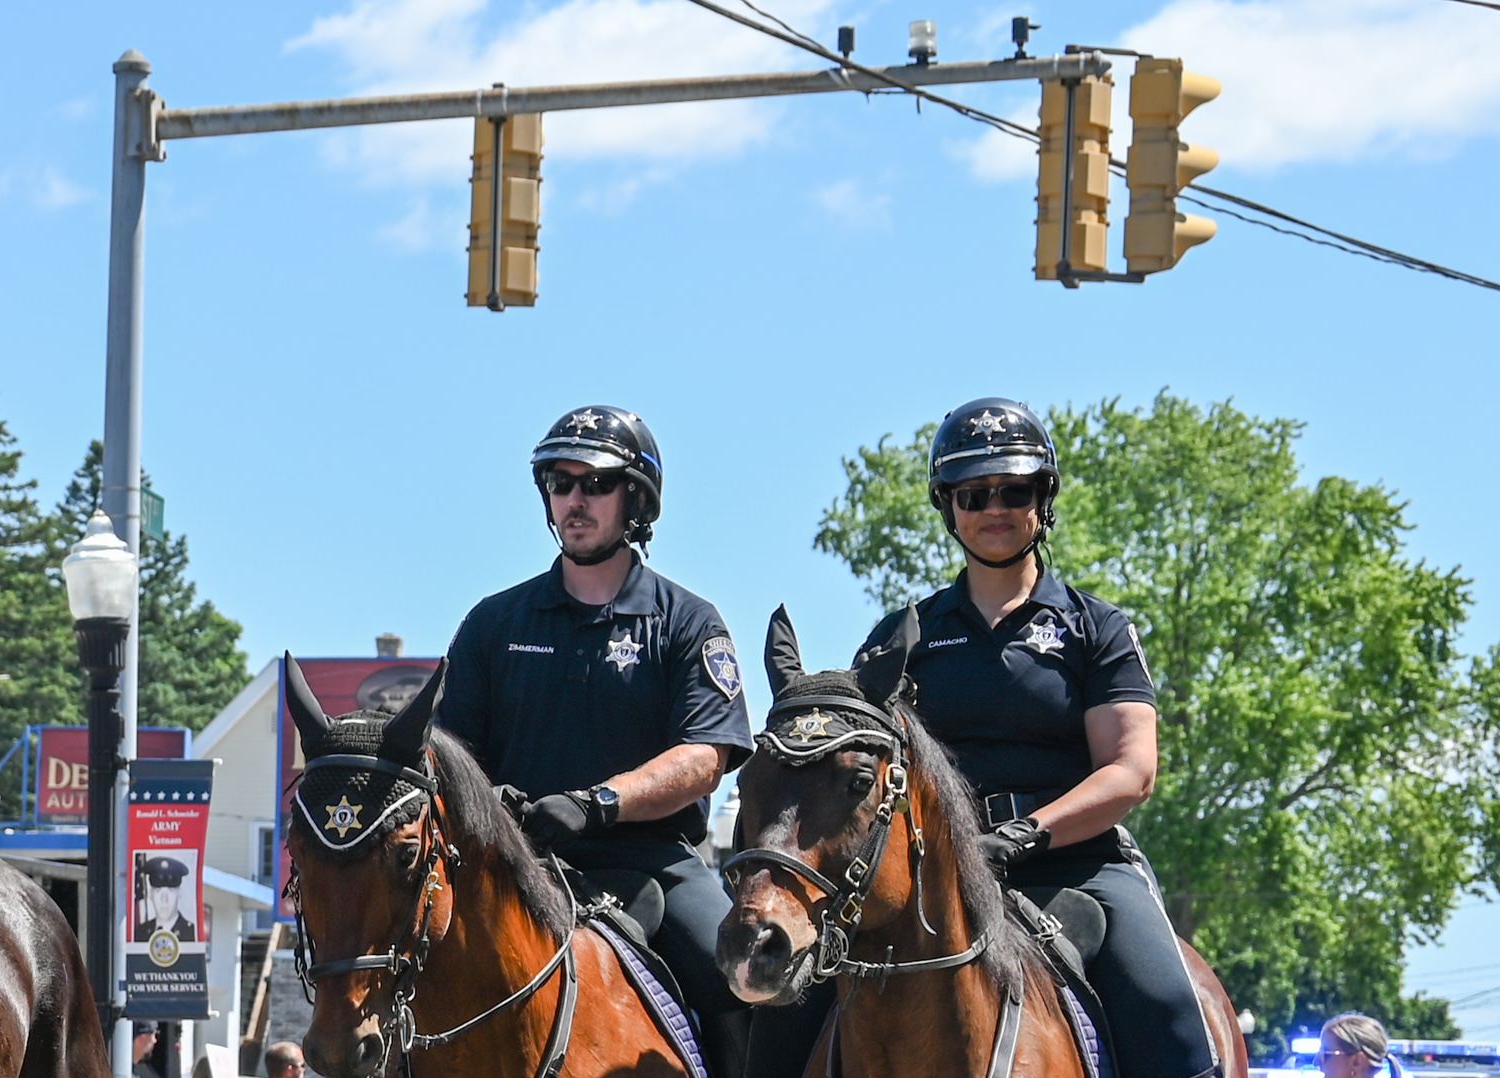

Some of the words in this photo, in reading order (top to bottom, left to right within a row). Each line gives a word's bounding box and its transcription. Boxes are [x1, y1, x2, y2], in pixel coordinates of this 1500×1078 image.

[928, 637, 968, 648] CAMACHO
[508, 643, 554, 654] ZIMMERMAN
[151, 821, 181, 832] ARMY
[148, 835, 182, 845] Vietnam
[134, 972, 148, 981] WE
[149, 972, 179, 981] THANK
[179, 972, 197, 981] YOU
[128, 984, 146, 992] FOR
[146, 984, 168, 992] YOUR
[170, 983, 205, 992] SERVICE
